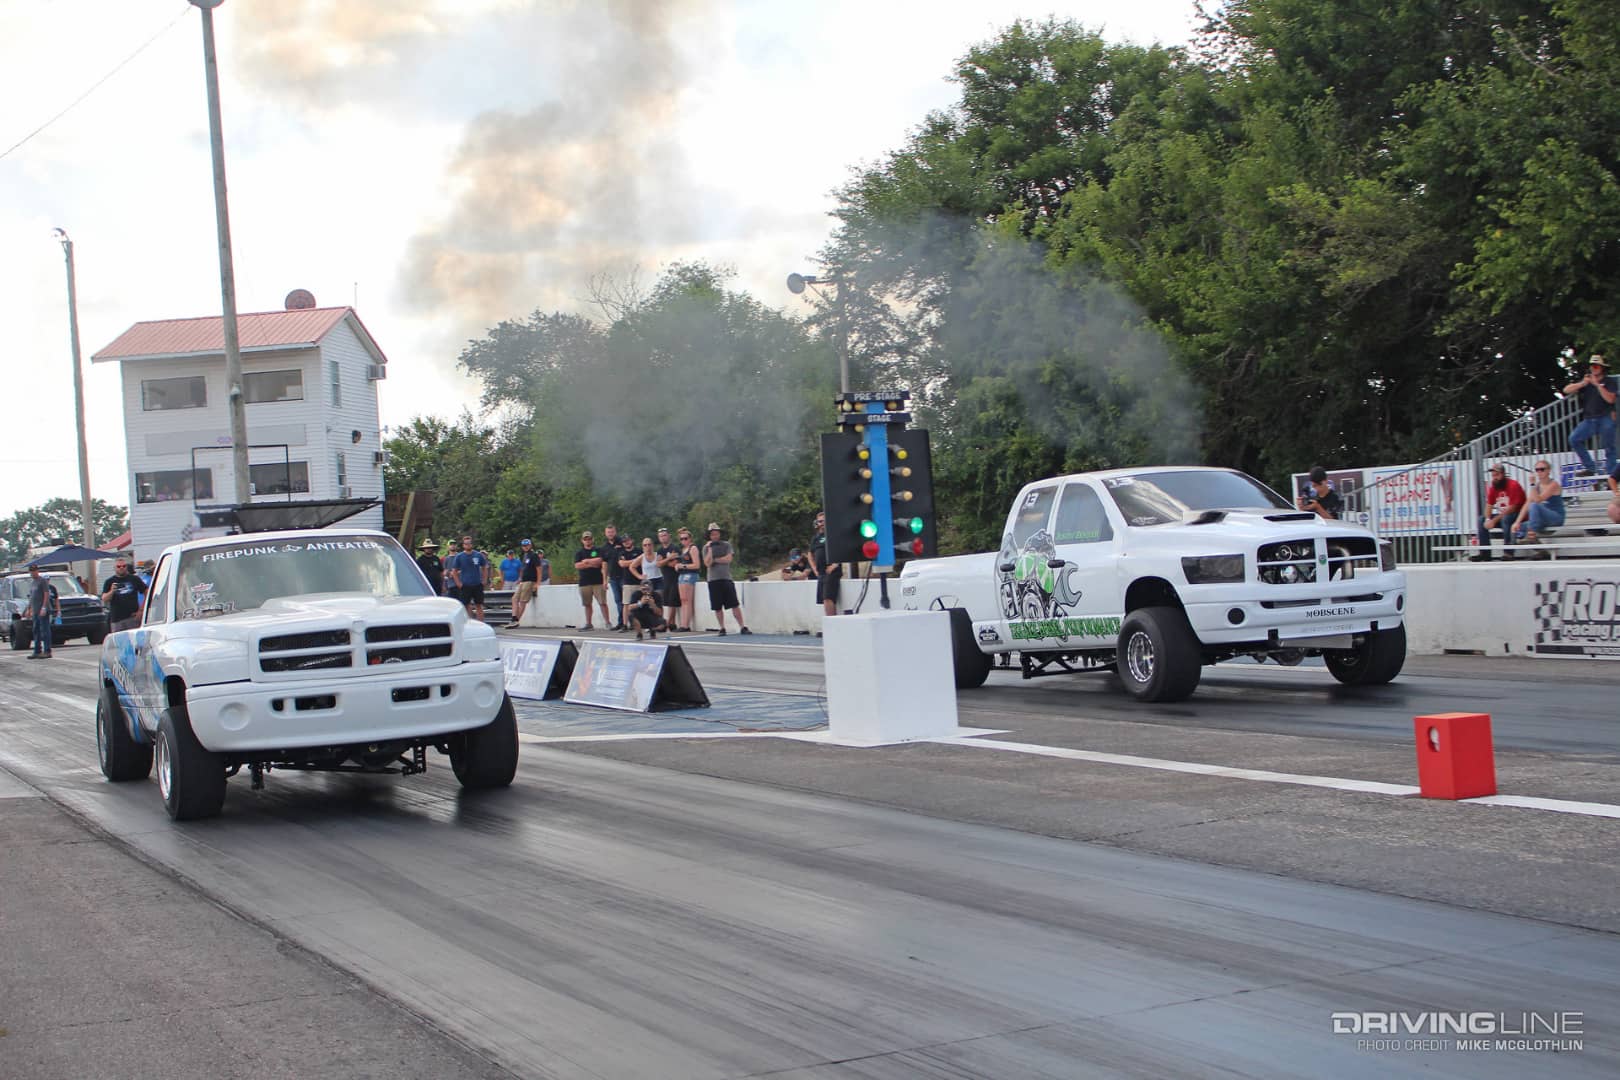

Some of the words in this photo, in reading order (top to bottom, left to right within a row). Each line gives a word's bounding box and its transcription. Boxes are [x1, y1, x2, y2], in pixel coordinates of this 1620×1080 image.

[867, 414, 892, 423] STAGE
[1385, 488, 1431, 504] CAMPING
[202, 545, 278, 563] FIREPUNK
[306, 541, 380, 551] ANTEATER
[1562, 581, 1620, 622] RO
[1305, 607, 1356, 618] MOBSCENE
